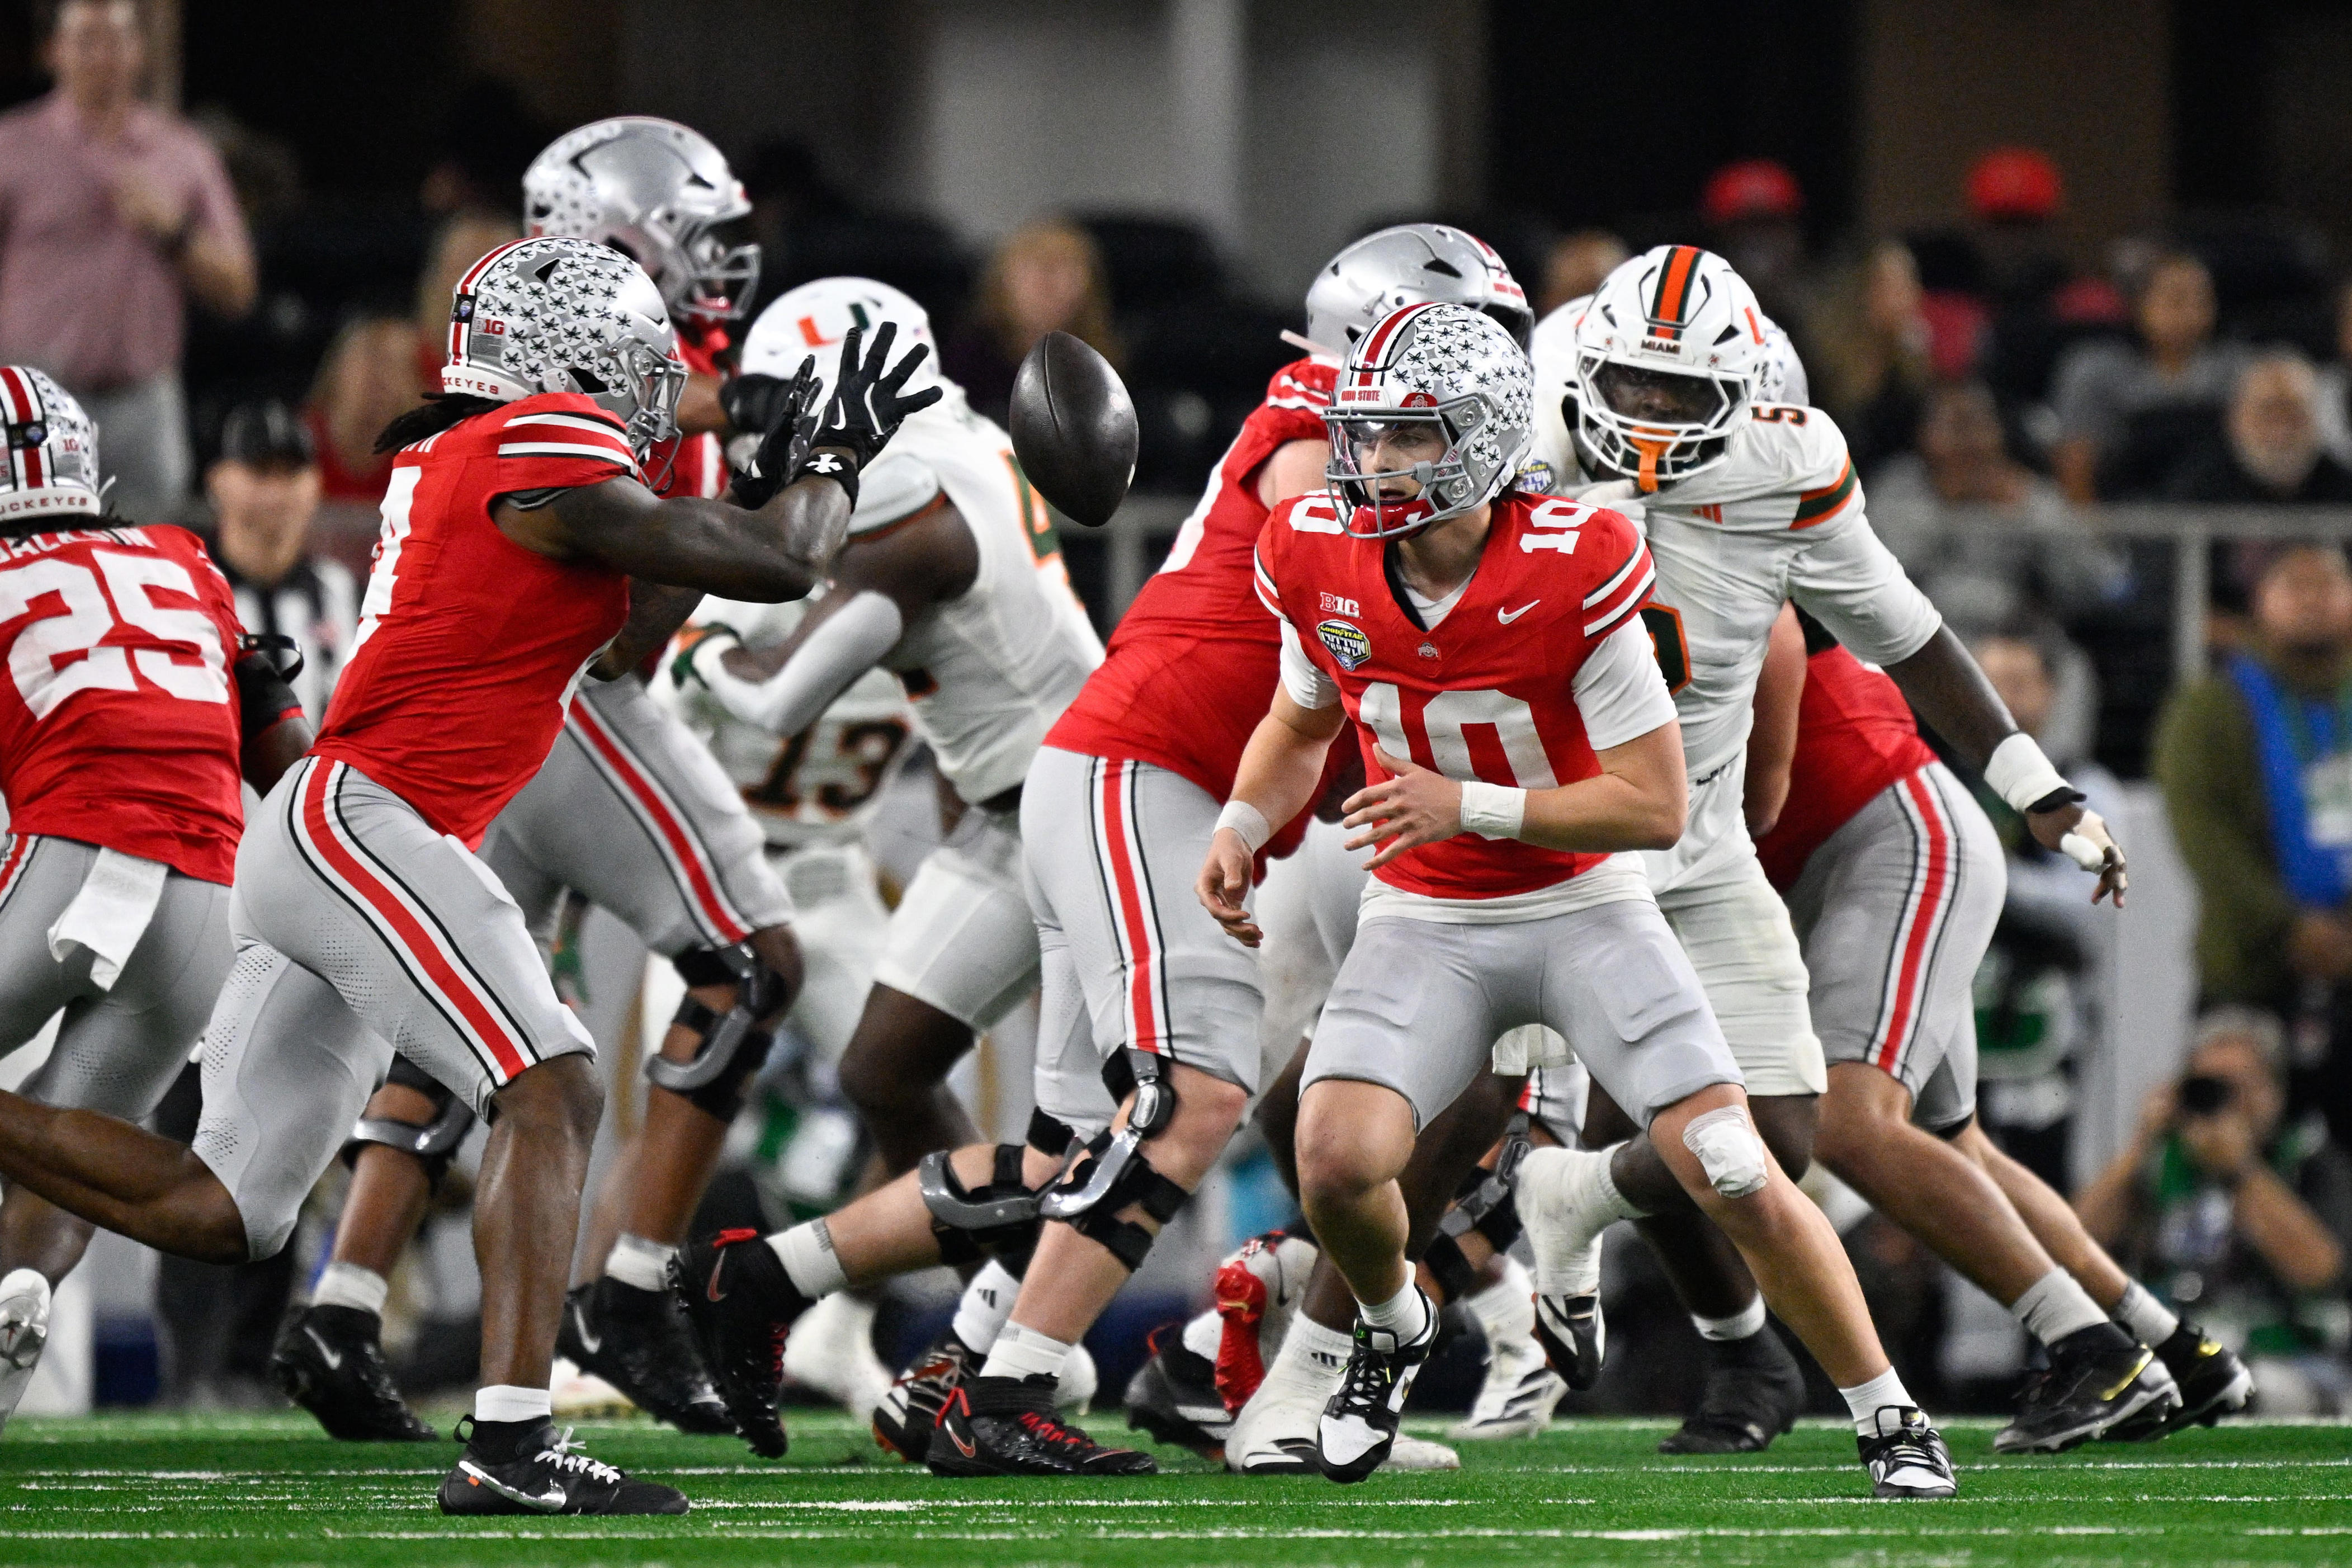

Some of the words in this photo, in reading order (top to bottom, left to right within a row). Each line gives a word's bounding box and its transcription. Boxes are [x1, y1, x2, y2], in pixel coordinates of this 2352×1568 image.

[1641, 339, 1681, 355] MIAMI
[1341, 391, 1356, 402] OHIO
[1358, 391, 1381, 402] STATE
[1750, 406, 1808, 427] 5
[1519, 499, 1598, 555] 10
[0, 549, 230, 721] 25
[1320, 625, 1363, 641] GOODYEAR
[1359, 681, 1560, 789] 10
